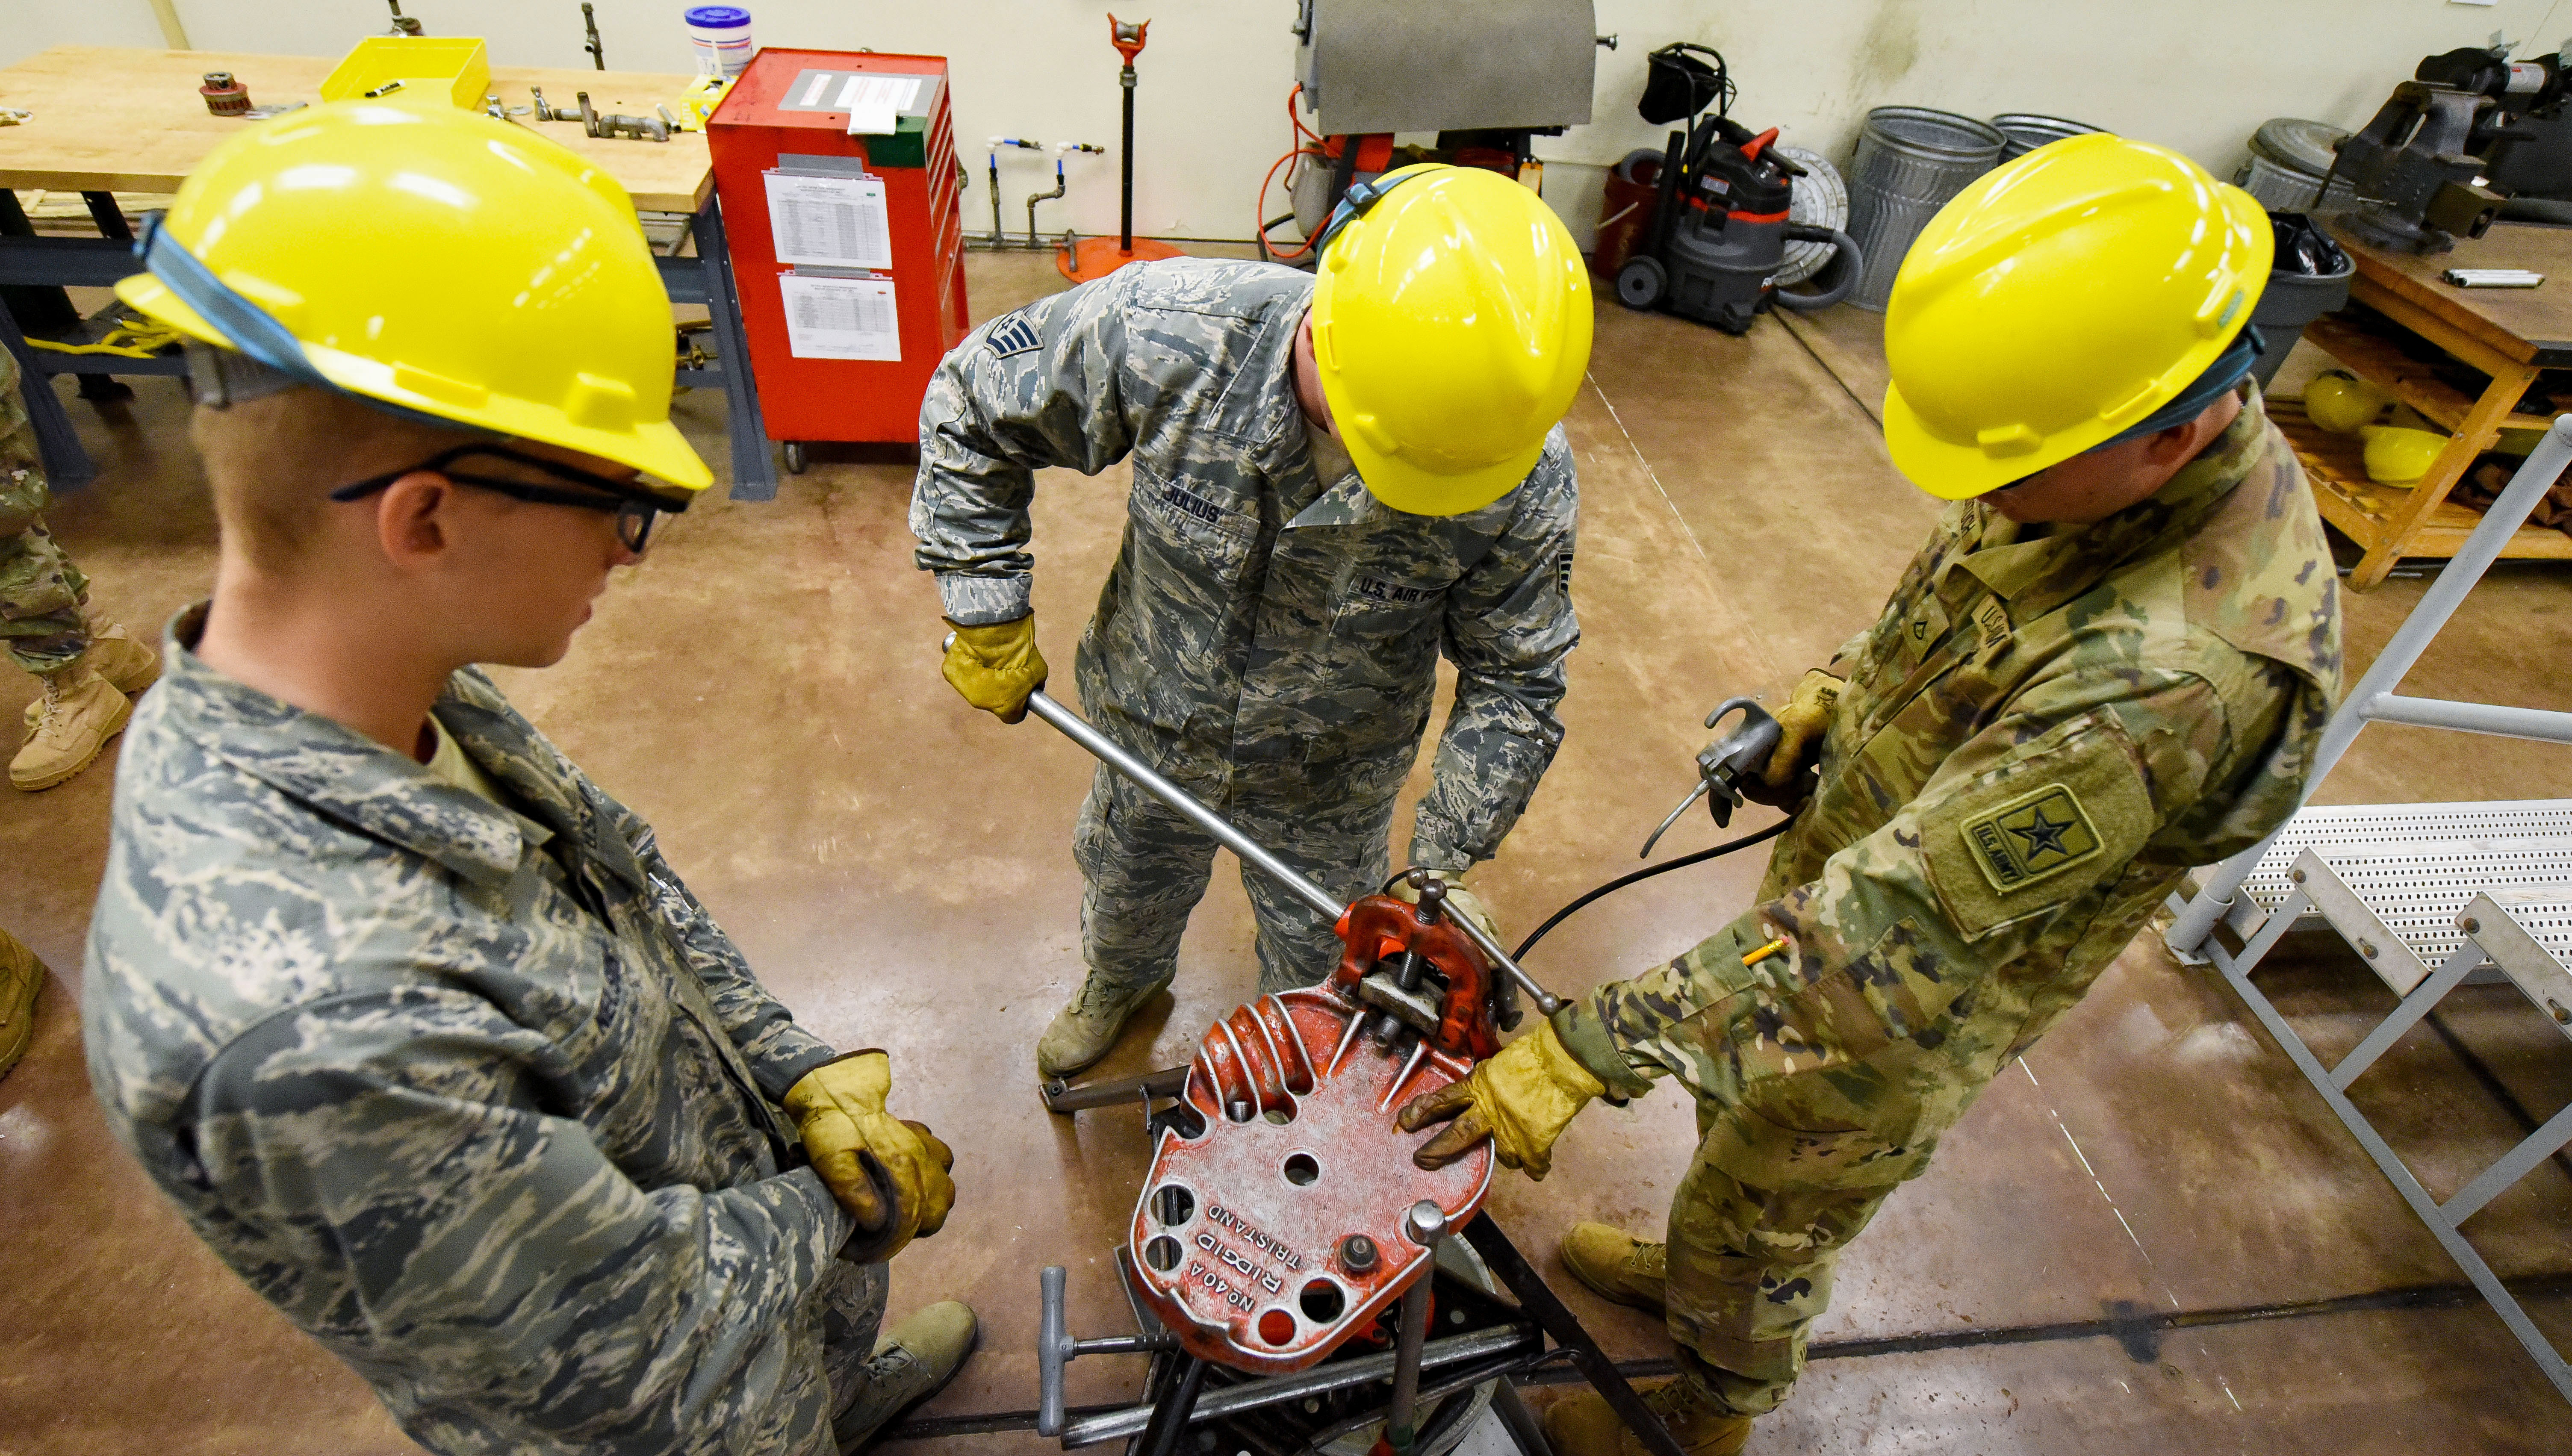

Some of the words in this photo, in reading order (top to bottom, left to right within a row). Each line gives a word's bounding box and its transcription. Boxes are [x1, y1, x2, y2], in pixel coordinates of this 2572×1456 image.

[1162, 487, 1220, 523] JULIUS
[1360, 578, 1386, 599] U.S.
[1391, 587, 1420, 602] AIR
[1988, 849, 2019, 877] ARMY
[1208, 1205, 1300, 1270] TRISTAND
[1197, 1233, 1282, 1294] RIDGID
